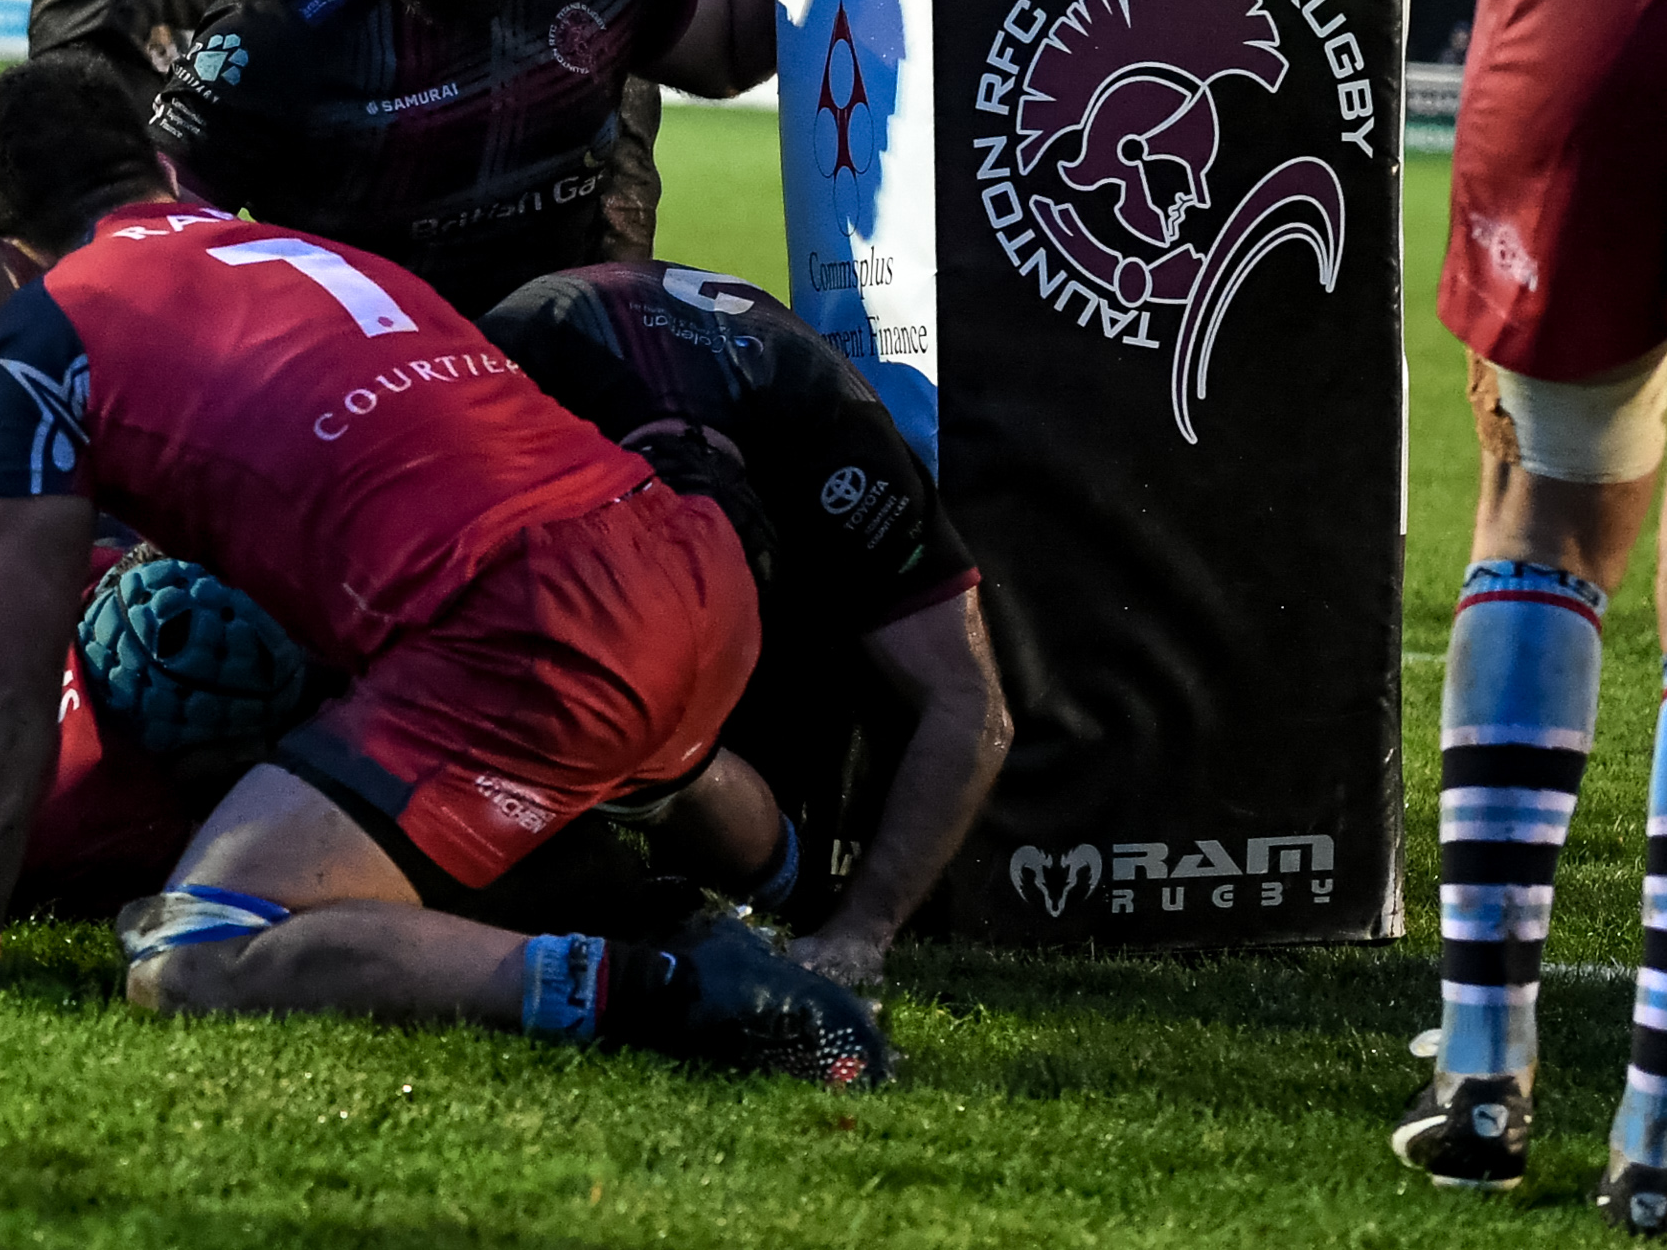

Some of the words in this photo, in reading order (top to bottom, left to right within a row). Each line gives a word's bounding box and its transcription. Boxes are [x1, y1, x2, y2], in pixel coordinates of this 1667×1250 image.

[381, 82, 459, 113] SAMURAI
[972, 135, 1161, 350] TAUNTON
[808, 246, 894, 301] Commsplus
[865, 314, 929, 357] Finance
[844, 479, 889, 530] TOYOTA
[1112, 833, 1334, 881] RAM
[1111, 878, 1334, 914] RUGBY
